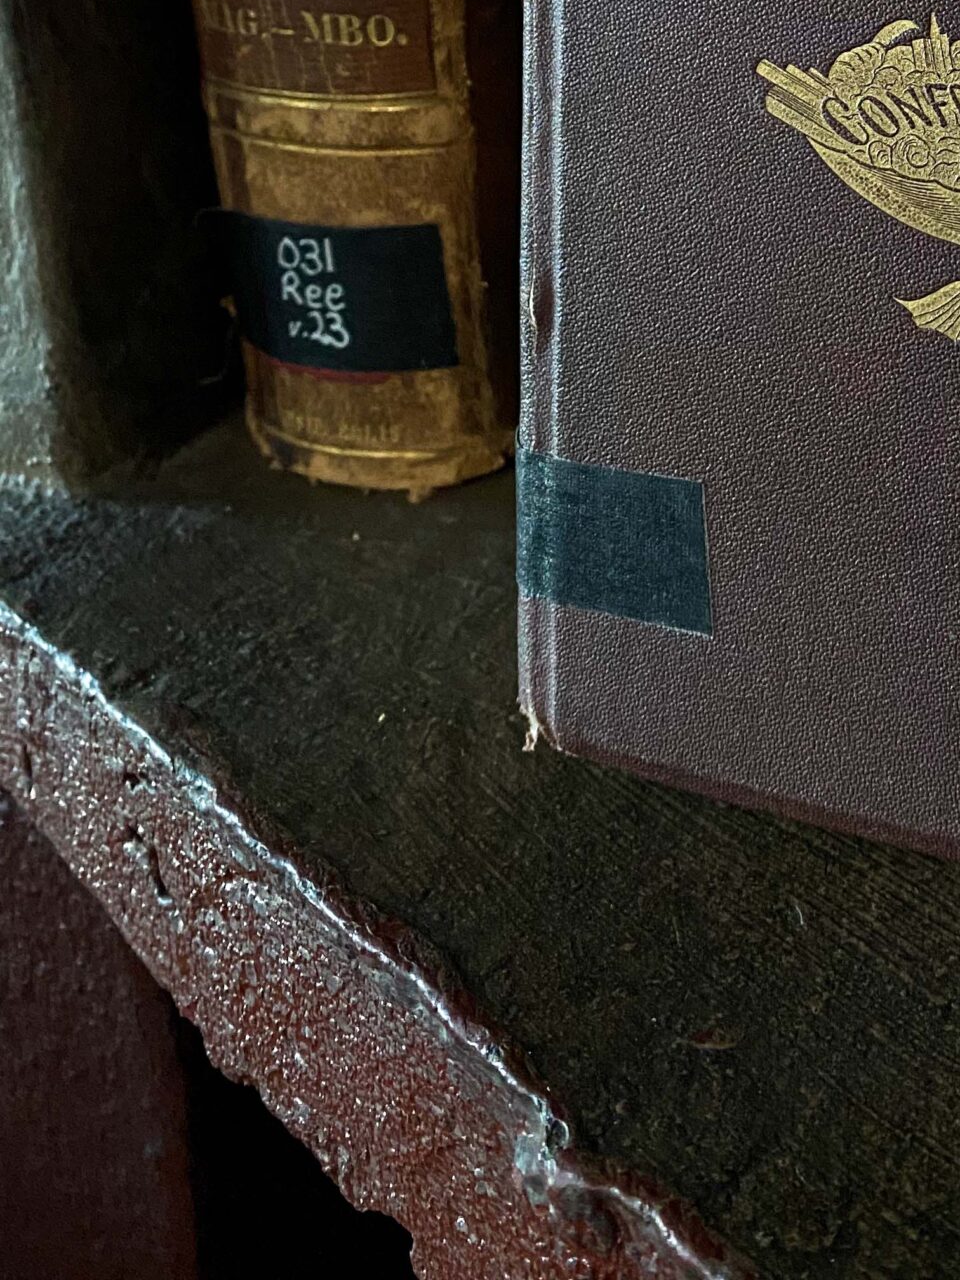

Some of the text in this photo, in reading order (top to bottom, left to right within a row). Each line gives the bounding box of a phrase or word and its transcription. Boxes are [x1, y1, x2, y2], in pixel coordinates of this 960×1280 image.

[277, 236, 334, 276] 031
[280, 270, 346, 311] Ree
[288, 311, 350, 349] v.23
